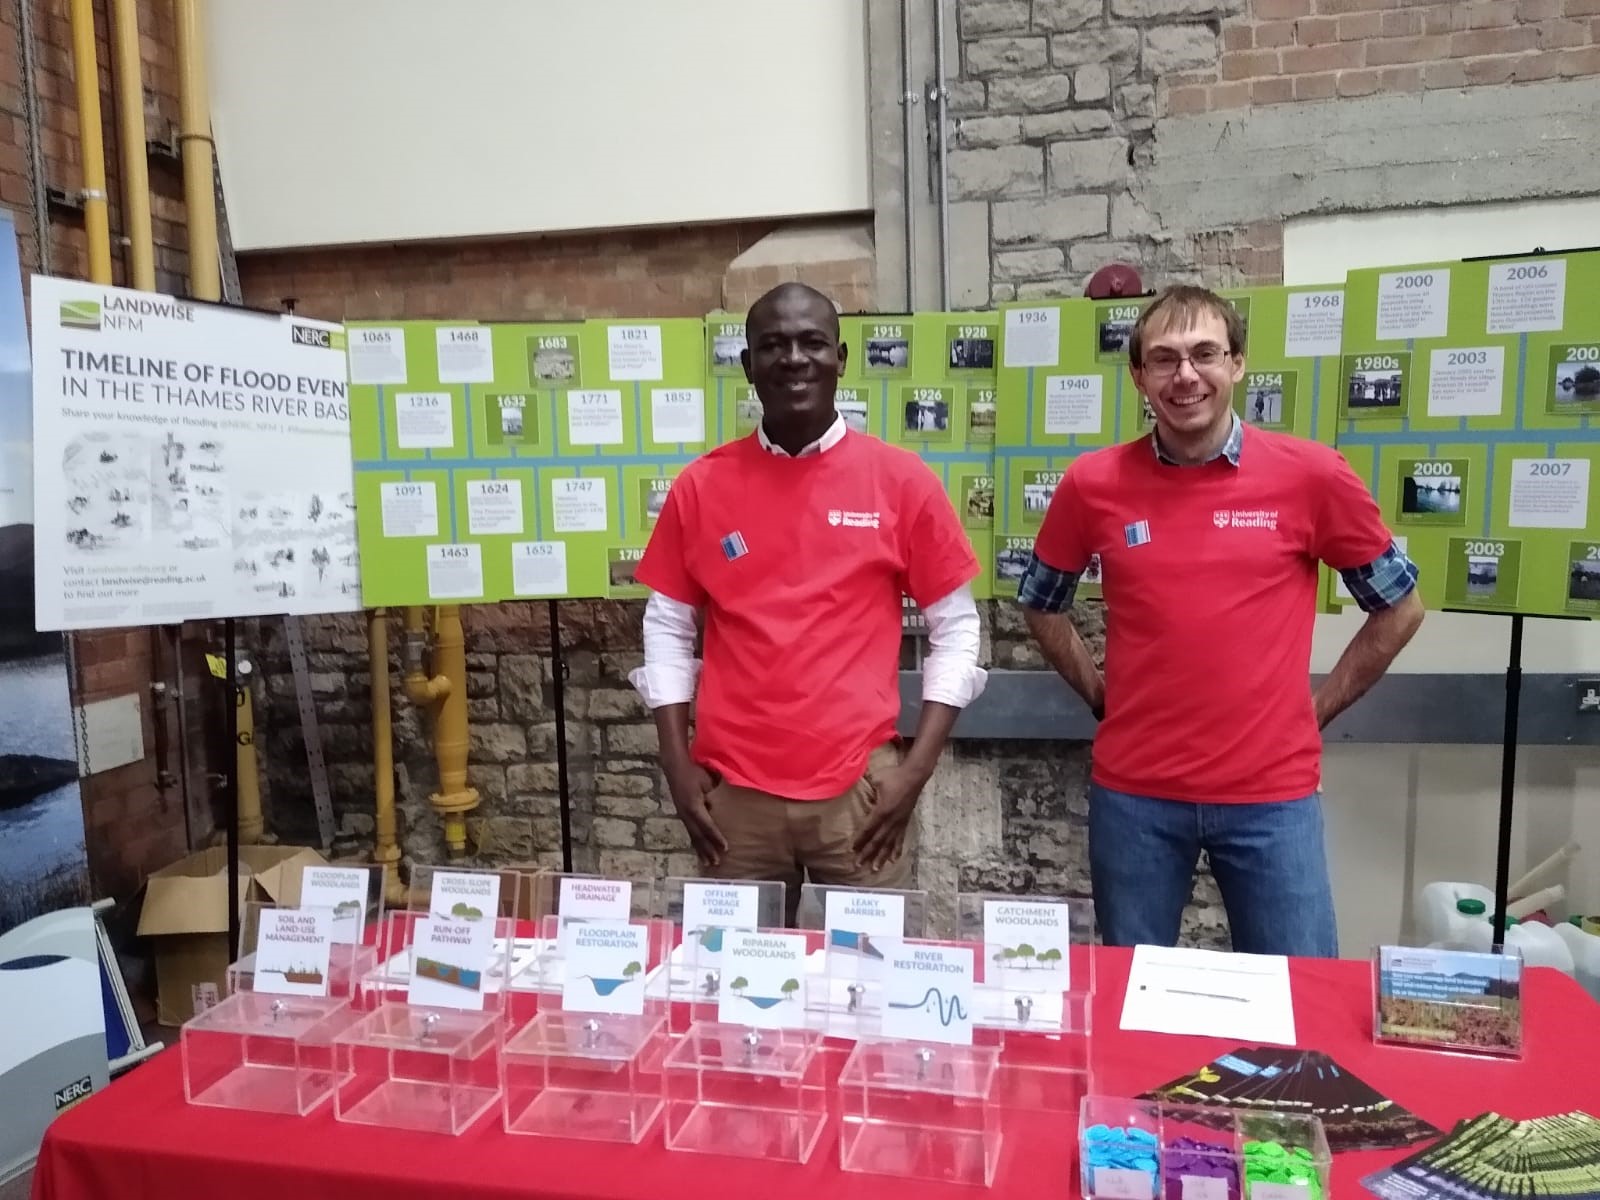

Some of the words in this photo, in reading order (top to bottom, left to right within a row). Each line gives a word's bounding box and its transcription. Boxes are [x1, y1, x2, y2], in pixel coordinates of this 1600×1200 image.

[1507, 265, 1548, 280] 2006
[1395, 274, 1434, 289] 2000
[1304, 295, 1340, 309] 1968
[103, 295, 195, 322] LANDWISE
[1108, 306, 1140, 320] 1940
[103, 314, 144, 333] NFM
[1018, 311, 1047, 324] 1936
[293, 326, 329, 346] NERC
[362, 331, 392, 343] 1065
[450, 330, 479, 343] 1468
[621, 329, 649, 341] 1821
[873, 326, 902, 337] 1915
[958, 326, 988, 338] 1928
[1448, 351, 1487, 366] 2003
[1566, 347, 1600, 361] 200
[1355, 356, 1400, 371] 1980s
[60, 348, 178, 381] TIMELINE
[183, 363, 215, 384] OF
[219, 366, 292, 393] FLOOD
[1060, 379, 1090, 391] 1940
[1248, 374, 1283, 387] 1954
[62, 375, 88, 398] IN
[96, 377, 146, 404] THE
[151, 383, 246, 412] THAMES
[252, 394, 308, 418] RIVER
[314, 400, 351, 422] BAS
[581, 393, 609, 405] 1771
[664, 391, 693, 403] 1852
[834, 389, 858, 401] 894
[913, 389, 942, 401] 1926
[979, 391, 996, 402] 19
[409, 396, 439, 408] 1216
[116, 411, 169, 425] knowledge
[1414, 463, 1453, 476] 2000
[1530, 463, 1572, 477] 2007
[481, 483, 509, 495] 1624
[565, 481, 593, 493] 1747
[650, 480, 672, 491] 185
[974, 477, 994, 489] 192
[395, 485, 423, 497] 1091
[1231, 510, 1269, 520] University
[1231, 517, 1278, 531] Reading
[441, 546, 470, 559] 1463
[525, 545, 554, 557] 1652
[1464, 542, 1504, 556] 2003
[312, 871, 360, 881] FLOODPLAIN
[311, 880, 360, 890] WOODLANDS
[571, 884, 622, 894] HEADWATER
[440, 886, 492, 897] WOODLANDS
[704, 889, 739, 899] OFFLINE
[575, 893, 617, 903] DRAINAGE
[702, 898, 740, 908] STORAGE
[851, 898, 881, 908] LEAKY
[707, 907, 735, 917] AREAS
[844, 907, 887, 918] BARRIERS
[997, 906, 1057, 918] CATCHMENT
[278, 915, 295, 924] SOIL
[297, 916, 316, 925] AND
[994, 916, 1060, 928] WOODLANDS
[275, 924, 317, 935] LAND-USE
[433, 925, 471, 935] RUN-OFF
[578, 928, 637, 939] FLOODPLAIN
[265, 934, 325, 945] MANAGEMENT
[431, 934, 473, 946] PATHWAY
[575, 937, 639, 949] RESTORATION
[742, 938, 787, 949] RIPARIAN
[732, 948, 797, 961] WOODLANDS
[914, 950, 944, 962] RIVER
[893, 958, 965, 974] RESTORATION
[55, 1077, 92, 1107] NERC
